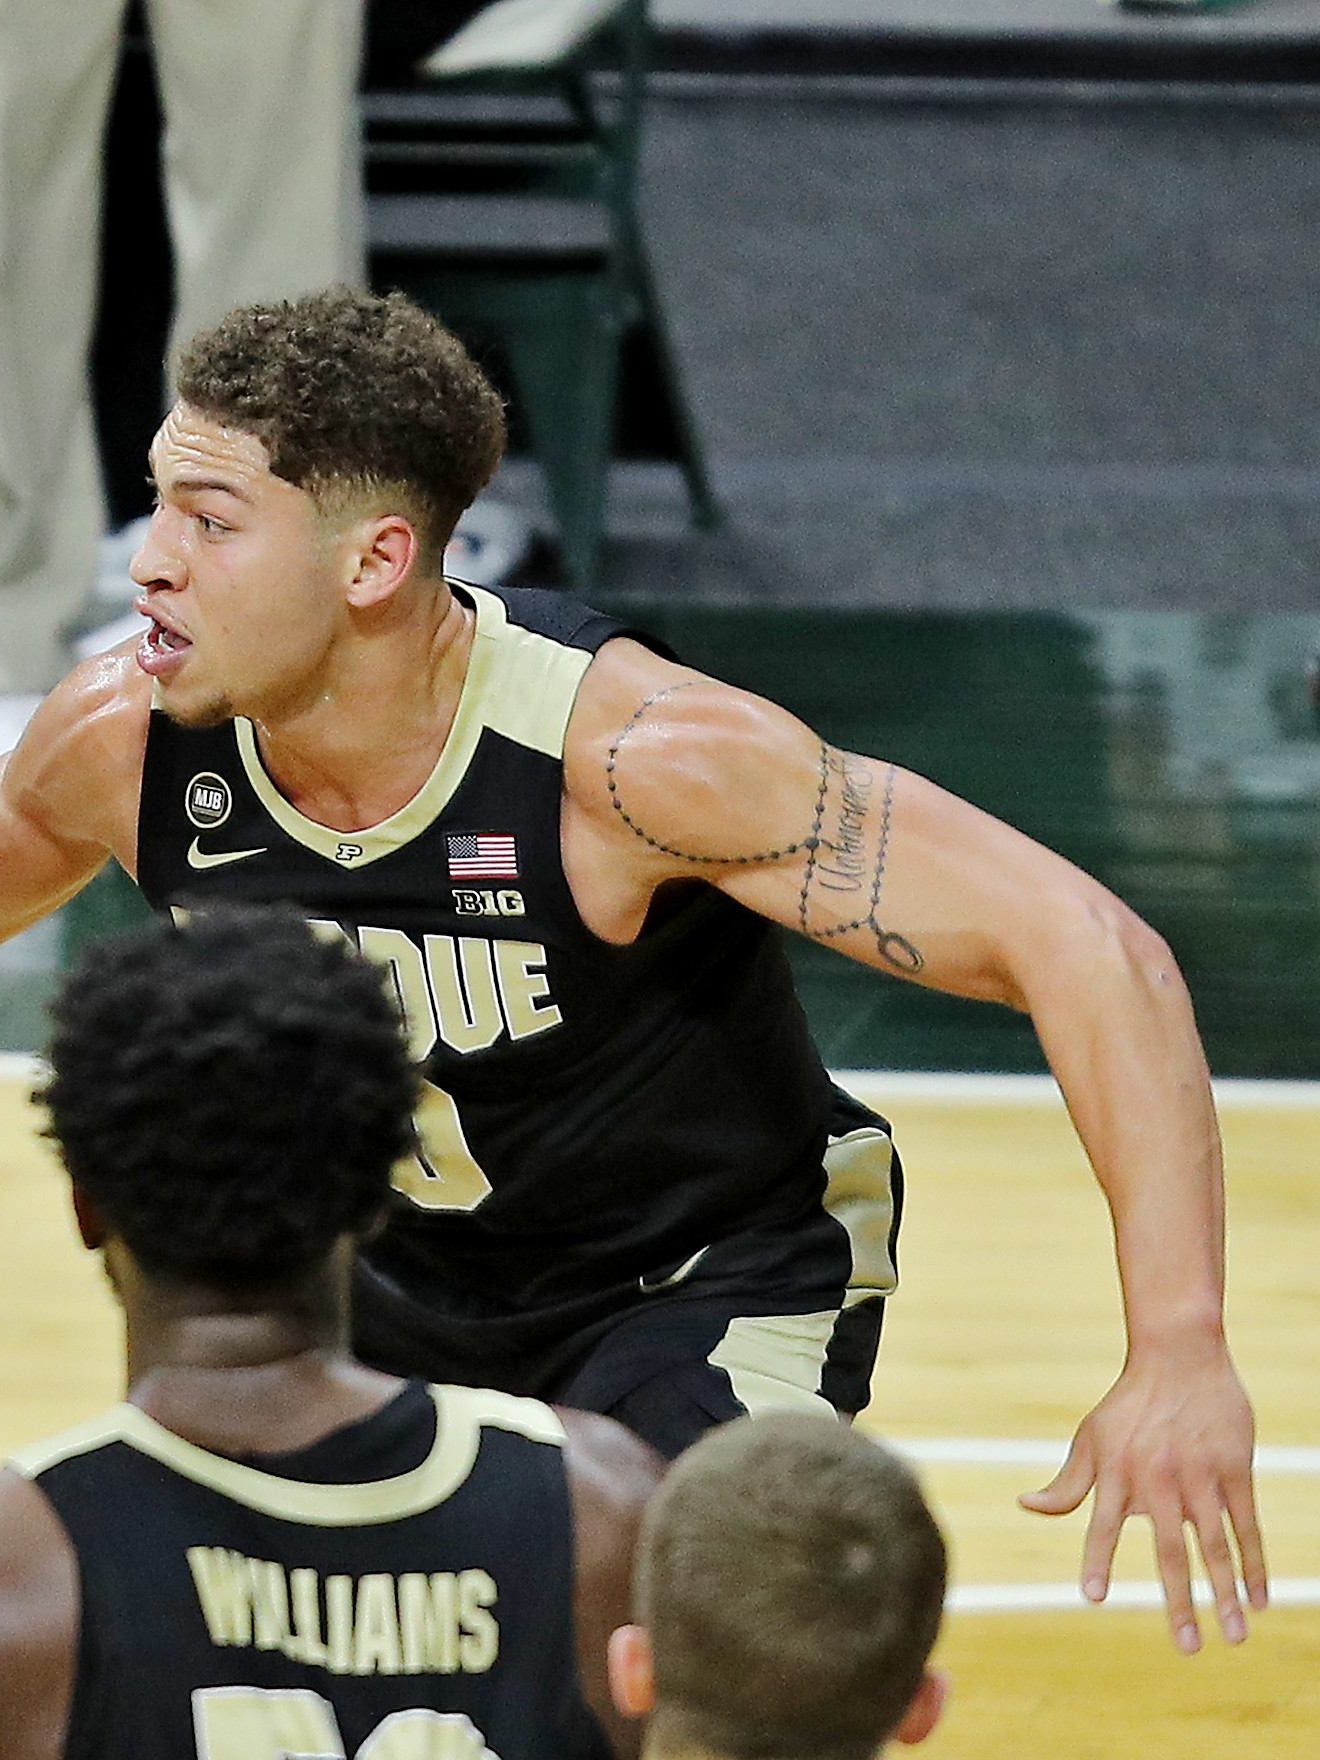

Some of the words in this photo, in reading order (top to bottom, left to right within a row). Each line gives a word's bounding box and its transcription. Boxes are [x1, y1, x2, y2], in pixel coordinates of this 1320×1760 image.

[194, 787, 223, 811] MJB
[335, 842, 363, 861] P
[185, 1545, 500, 1676] WILLIAMS
